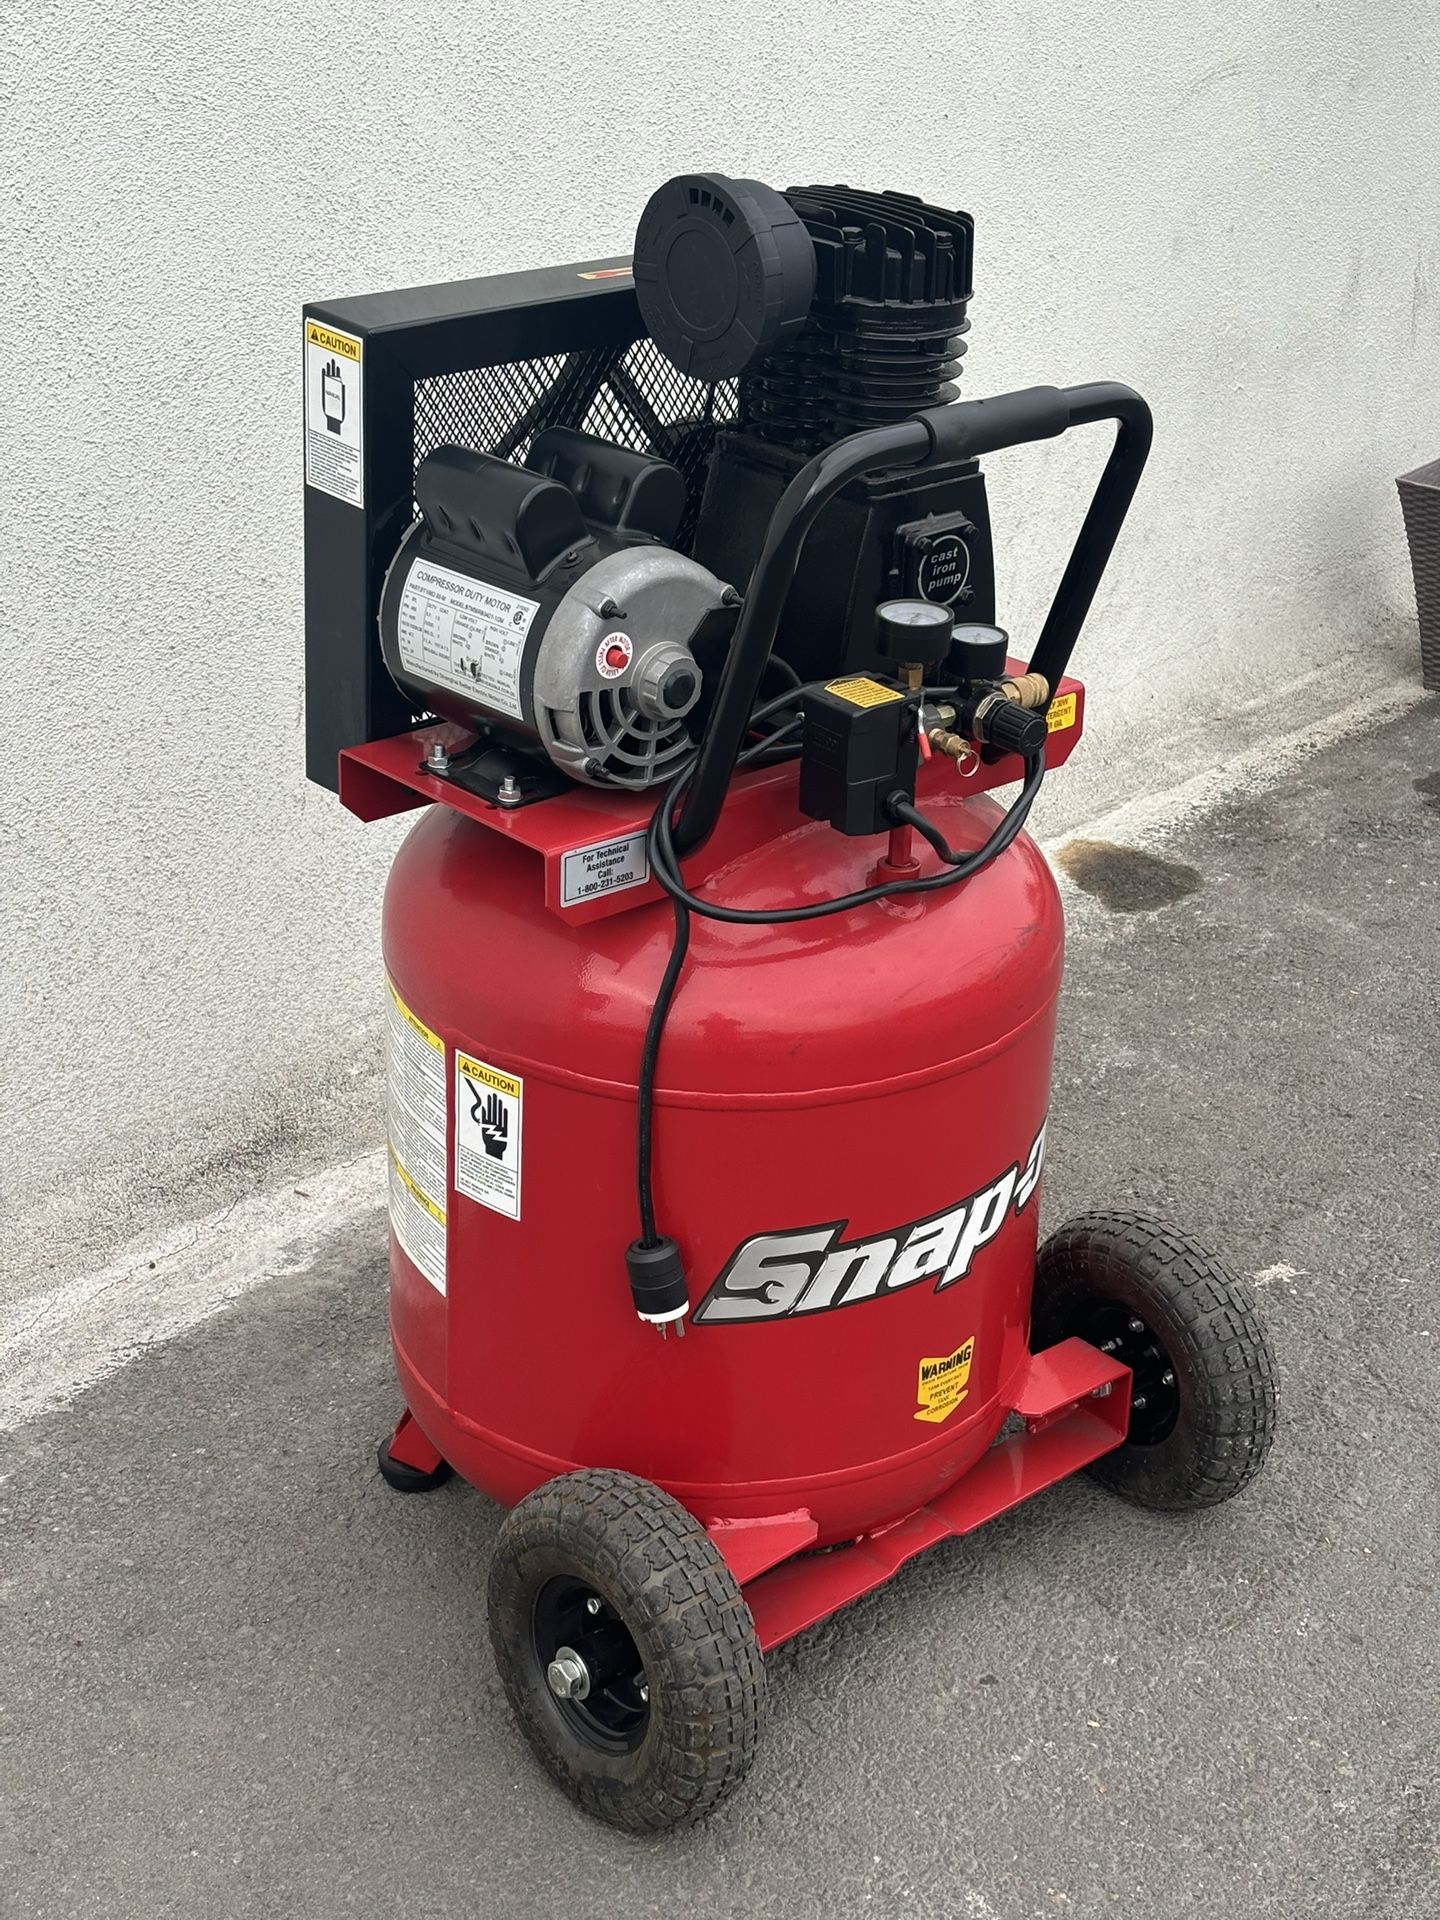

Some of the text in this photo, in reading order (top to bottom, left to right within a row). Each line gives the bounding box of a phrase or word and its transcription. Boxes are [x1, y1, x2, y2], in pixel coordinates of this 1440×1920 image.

[320, 333, 356, 356] CAUTION
[931, 546, 959, 563] cast
[932, 562, 957, 576] iron
[417, 570, 465, 596] COMPRESSOR
[464, 588, 485, 602] DUTY
[484, 596, 512, 613] MOTOR
[928, 573, 961, 592] pump
[605, 635, 618, 646] AFTER
[582, 843, 630, 864] For Technical
[586, 855, 625, 873] Assistance
[597, 868, 613, 879] Call:
[577, 871, 634, 895] 1-800-231-5203
[471, 1066, 515, 1094] CAUTION
[922, 1344, 972, 1381] WARNING
[929, 1382, 959, 1401] PREVENT
[926, 1397, 959, 1416] CORROSION
